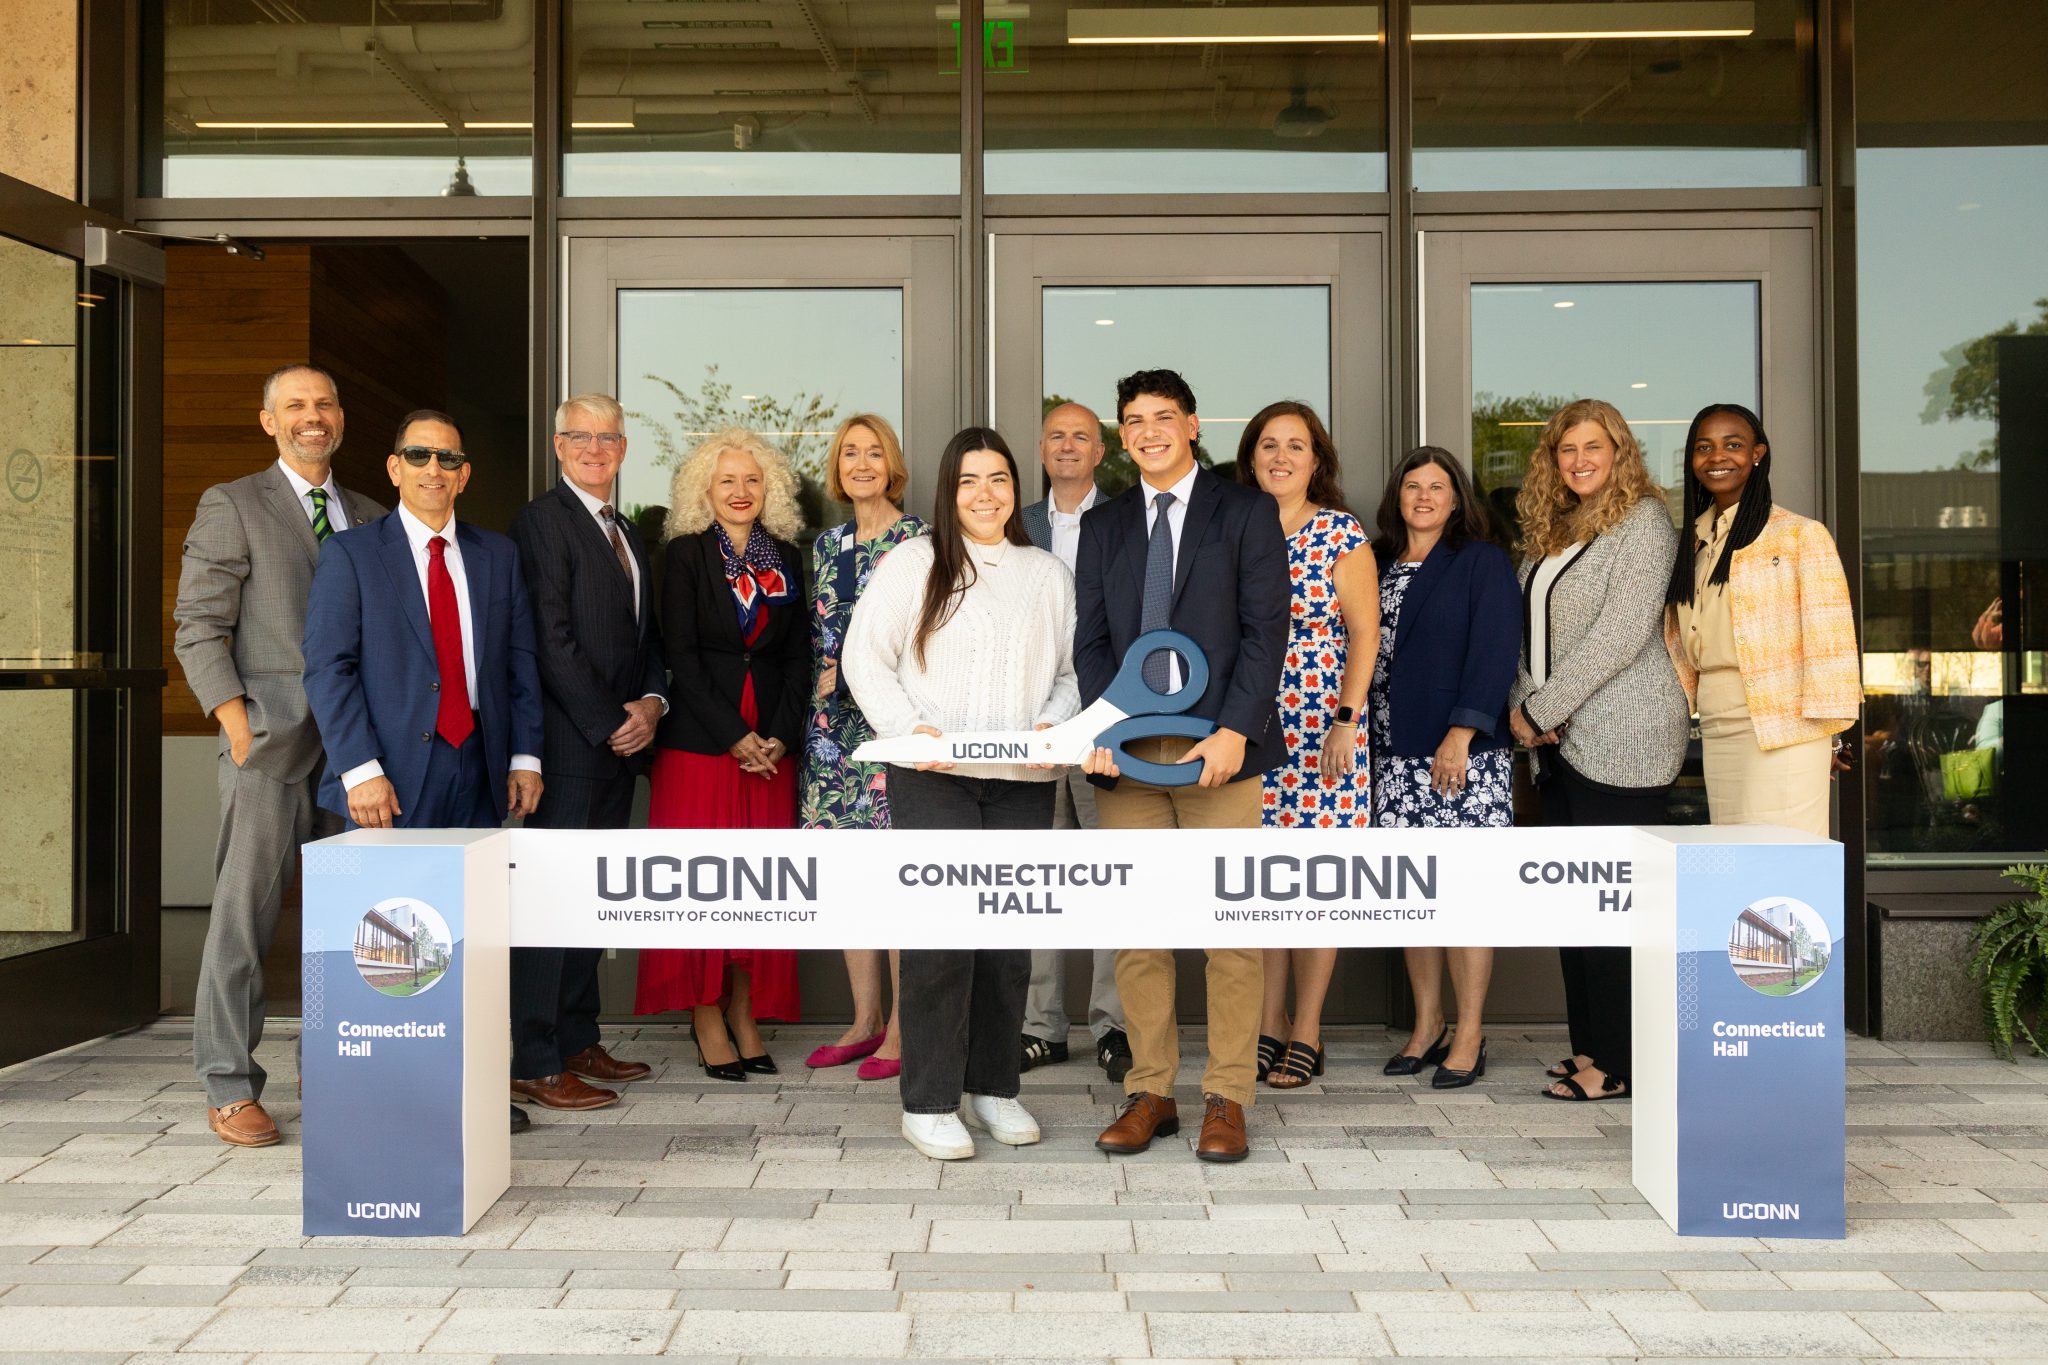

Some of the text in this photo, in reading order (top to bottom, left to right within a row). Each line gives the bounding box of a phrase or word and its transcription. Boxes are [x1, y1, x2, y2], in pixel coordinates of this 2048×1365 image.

[953, 743, 1028, 759] UCONN
[597, 855, 818, 902] UCONN
[899, 863, 1134, 885] CONNECTICUT
[1215, 855, 1437, 902] UCONN
[978, 891, 1063, 914] HALL
[598, 910, 818, 922] UNIVERSITY OF CONNECTICUT
[1215, 909, 1437, 922] UNIVERSITY OF CONNECTICUT
[338, 1021, 446, 1038] Connecticut
[1712, 1021, 1826, 1038] Connecticut
[338, 1041, 371, 1057] Hall
[1713, 1041, 1749, 1057] Hall
[347, 1202, 421, 1220] UCONN
[1723, 1202, 1800, 1220] UCONN
